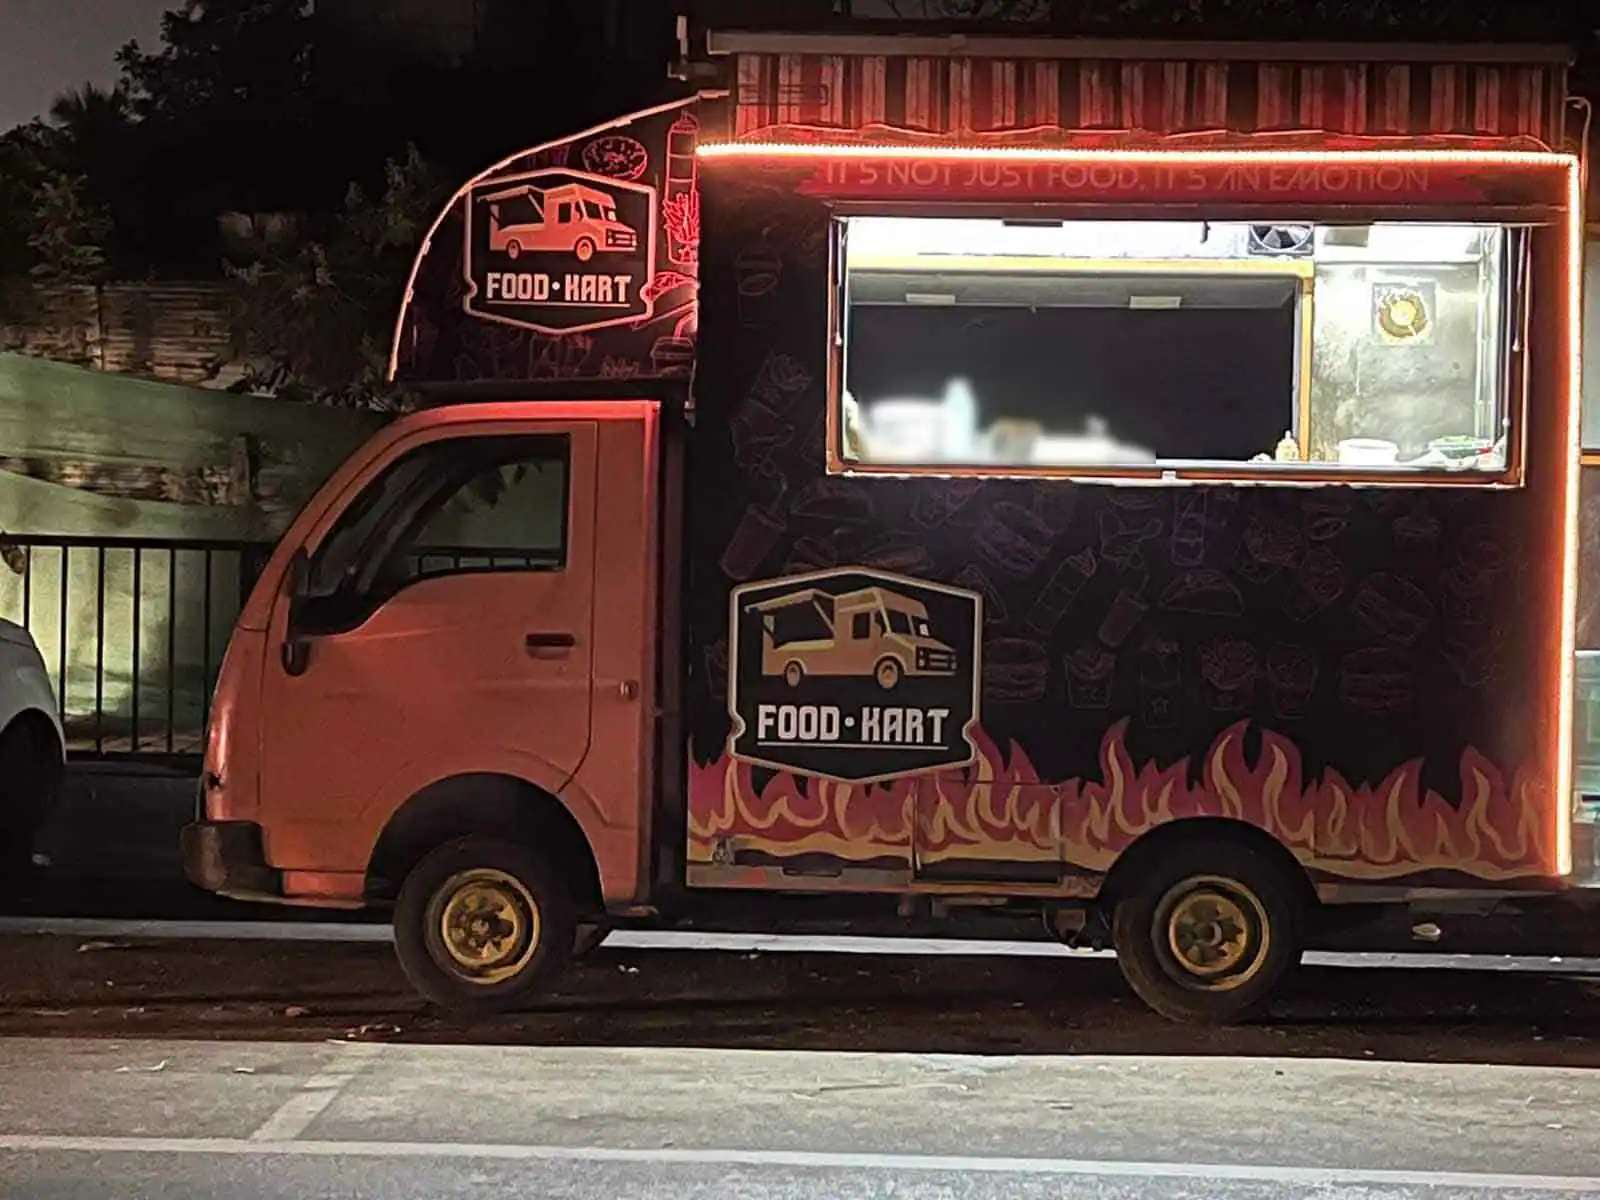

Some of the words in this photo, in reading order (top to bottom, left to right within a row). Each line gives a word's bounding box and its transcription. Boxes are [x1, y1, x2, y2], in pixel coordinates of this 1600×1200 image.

[827, 161, 879, 185] ITS
[886, 161, 957, 186] NOT
[962, 163, 1038, 188] JUST
[1153, 165, 1207, 190] ITS
[1214, 165, 1261, 190] AN
[1269, 165, 1428, 191] EMOTION
[486, 272, 549, 300] FOOD
[564, 274, 632, 302] KART
[757, 704, 840, 740] FOOD
[861, 707, 950, 743] KART
